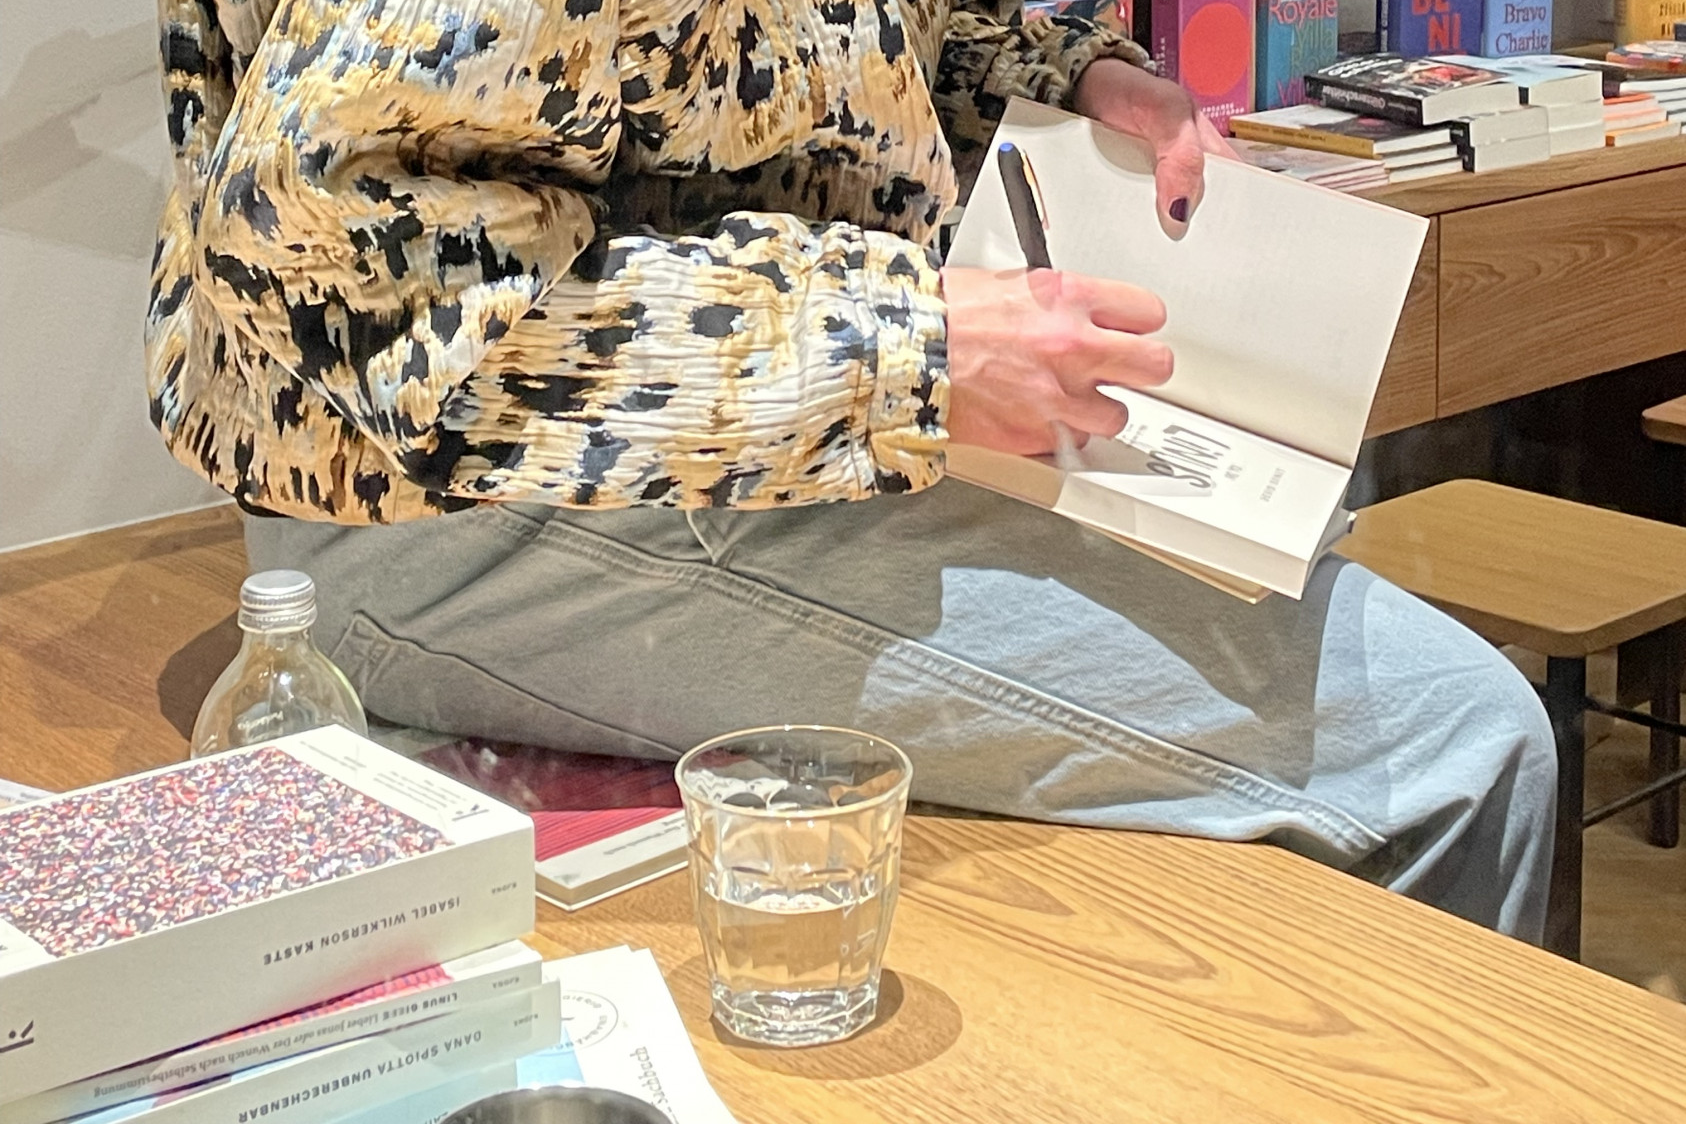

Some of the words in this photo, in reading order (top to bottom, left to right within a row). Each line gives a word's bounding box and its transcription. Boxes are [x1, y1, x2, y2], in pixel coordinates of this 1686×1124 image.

[1503, 2, 1547, 25] Bravo
[1428, 14, 1461, 53] NI
[1495, 29, 1549, 55] Charlie
[411, 896, 460, 920] ISABEL
[320, 914, 406, 950] WILKERSON
[263, 940, 314, 966] KASTE
[422, 992, 458, 1011] LINUS
[317, 1018, 346, 1038] Jonas
[346, 1011, 379, 1030] Lieber
[273, 1036, 292, 1051] Der
[294, 1030, 316, 1045] oder
[443, 1029, 482, 1053] DANA
[198, 1054, 227, 1072] nach
[228, 1042, 271, 1063] Wunsch
[377, 1046, 439, 1076] SPIOTTA
[93, 1061, 196, 1099] Selbstbestimmung
[238, 1067, 372, 1124] UNBERECHENBAR
